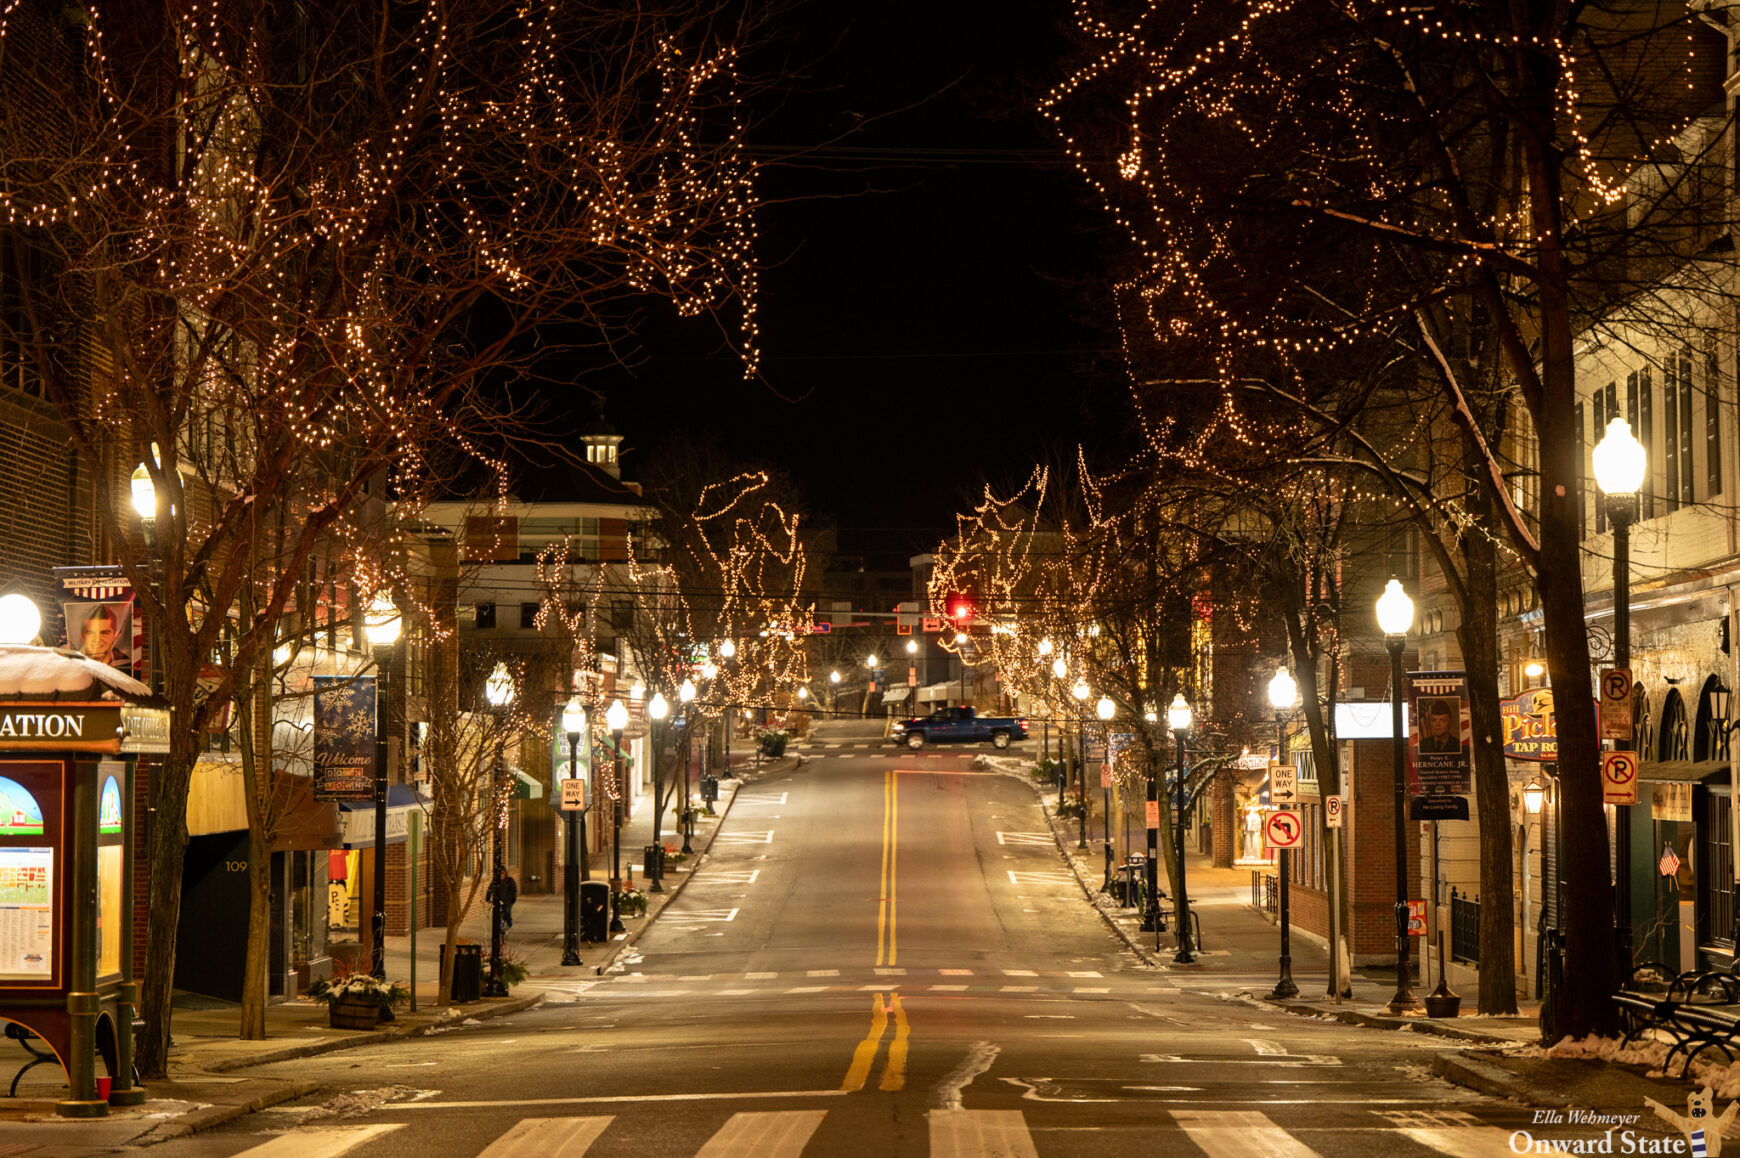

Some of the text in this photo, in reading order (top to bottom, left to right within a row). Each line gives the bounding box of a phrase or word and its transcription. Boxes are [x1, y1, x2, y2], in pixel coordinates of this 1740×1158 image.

[1502, 705, 1520, 714] Bill
[1513, 742, 1539, 753] TAP
[317, 751, 372, 766] Welcome
[1275, 770, 1292, 778] ONE
[1275, 780, 1293, 788] WAY
[225, 861, 248, 872] 109
